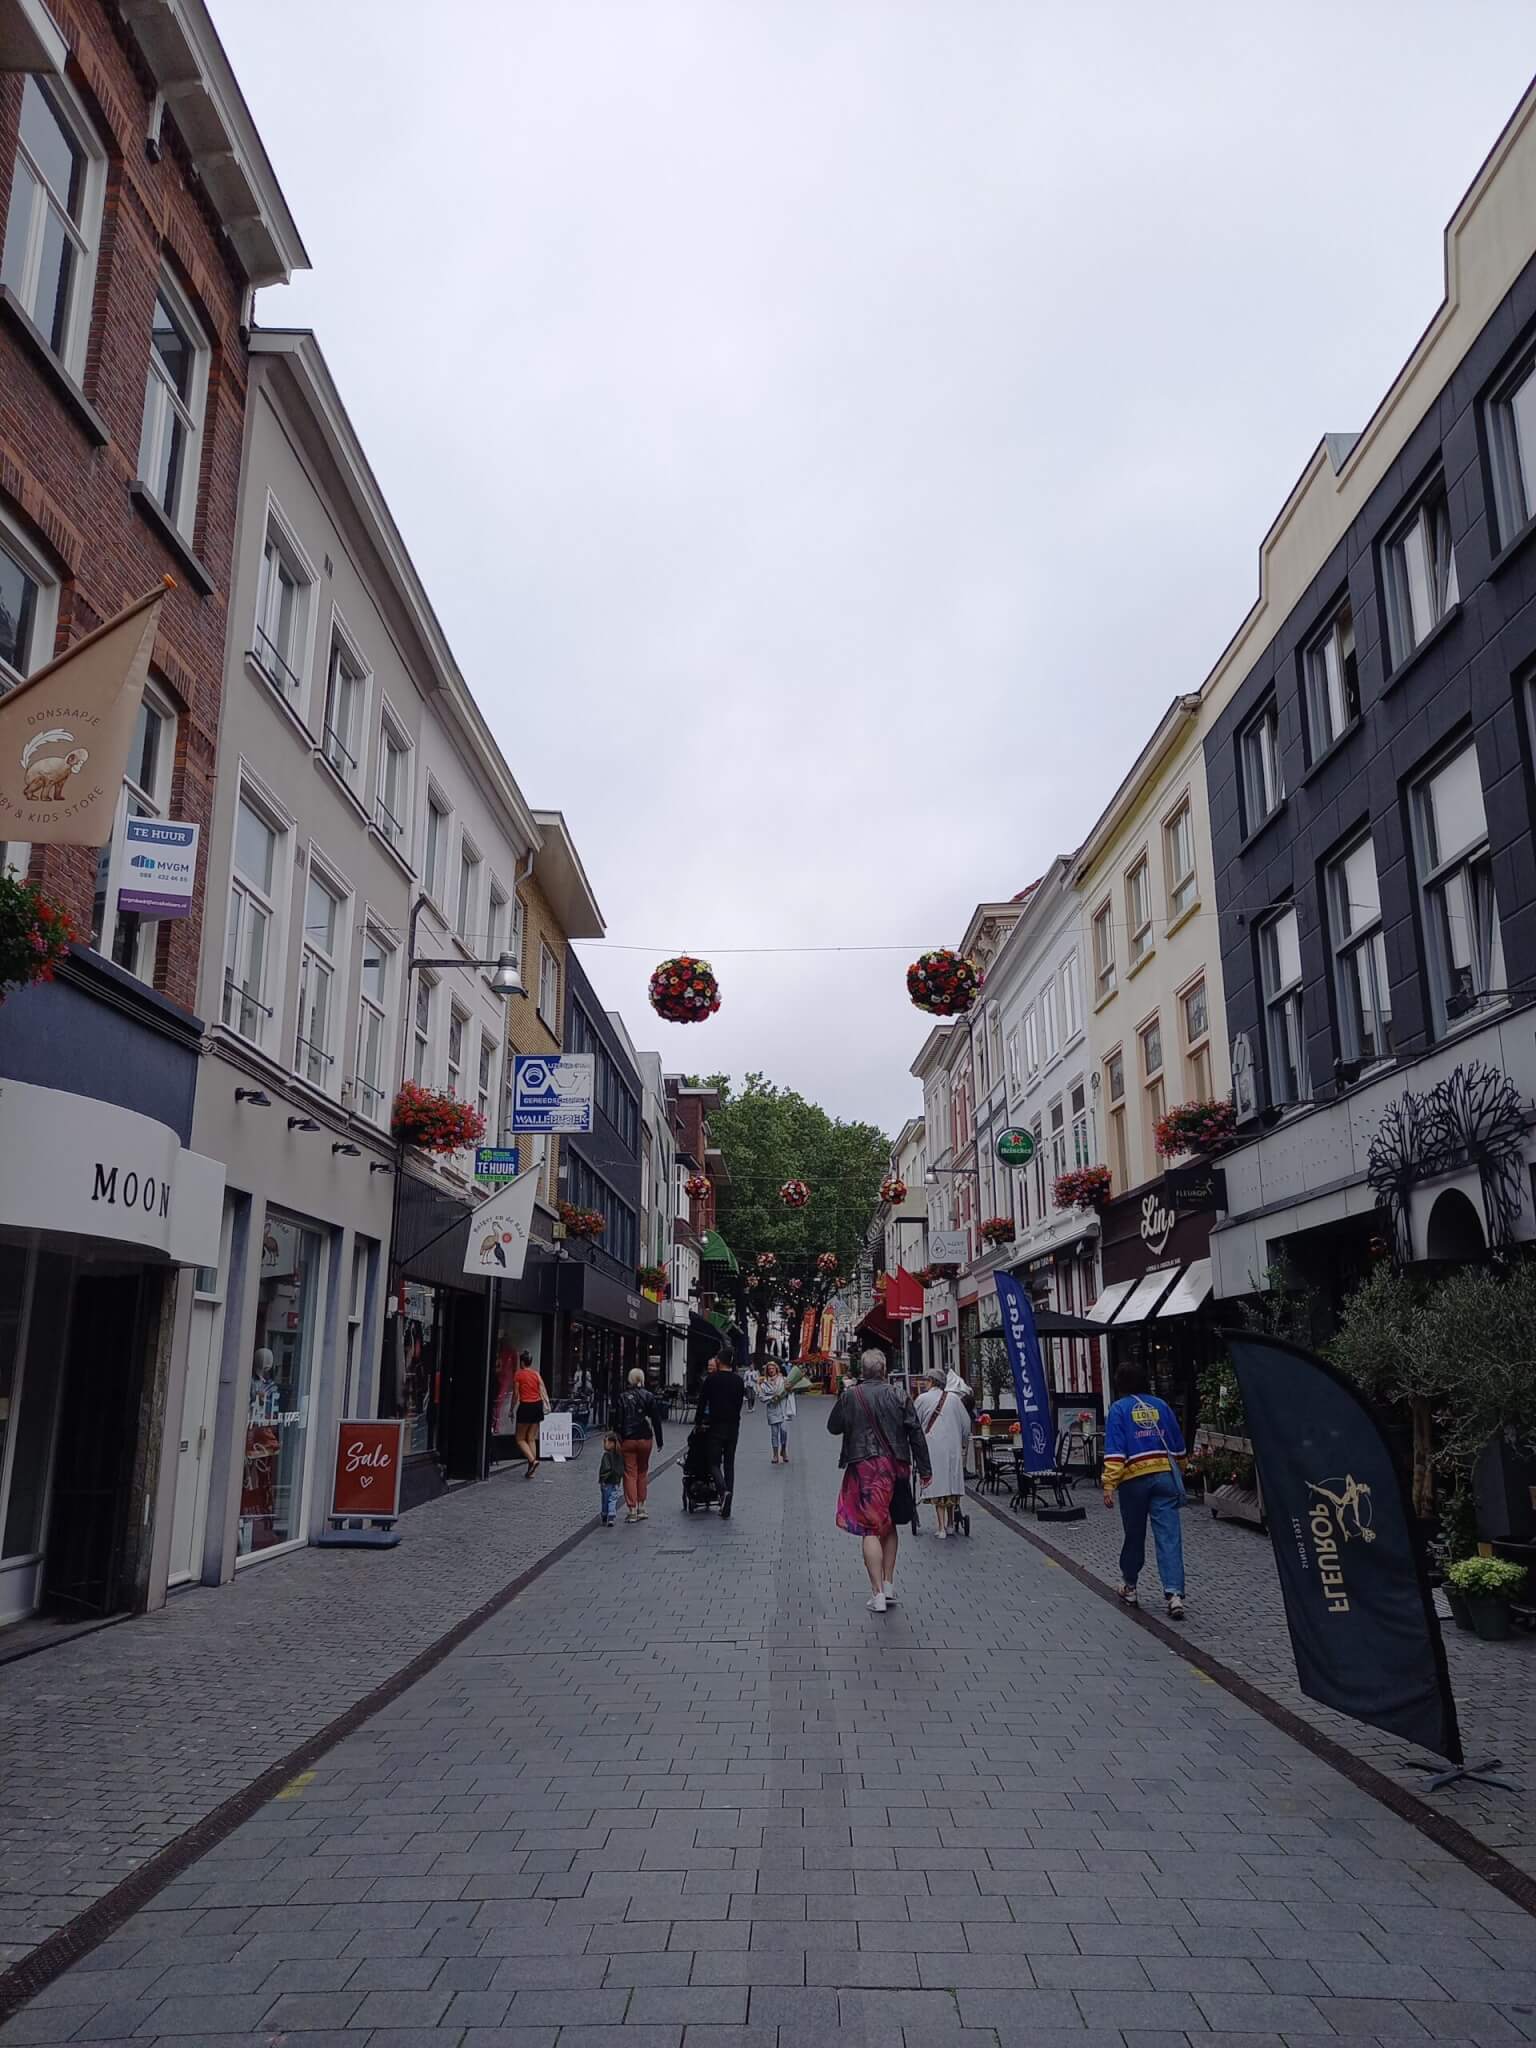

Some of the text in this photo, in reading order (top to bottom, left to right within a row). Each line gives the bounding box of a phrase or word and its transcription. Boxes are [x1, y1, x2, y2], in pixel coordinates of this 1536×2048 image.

[28, 813, 59, 823] KIDS
[64, 786, 104, 817] STORE
[133, 827, 186, 842] TE HUUR
[157, 861, 189, 872] MVGM
[477, 1162, 515, 1175] TE HUUR
[91, 1163, 170, 1219] MOON
[345, 1441, 391, 1472] Sale
